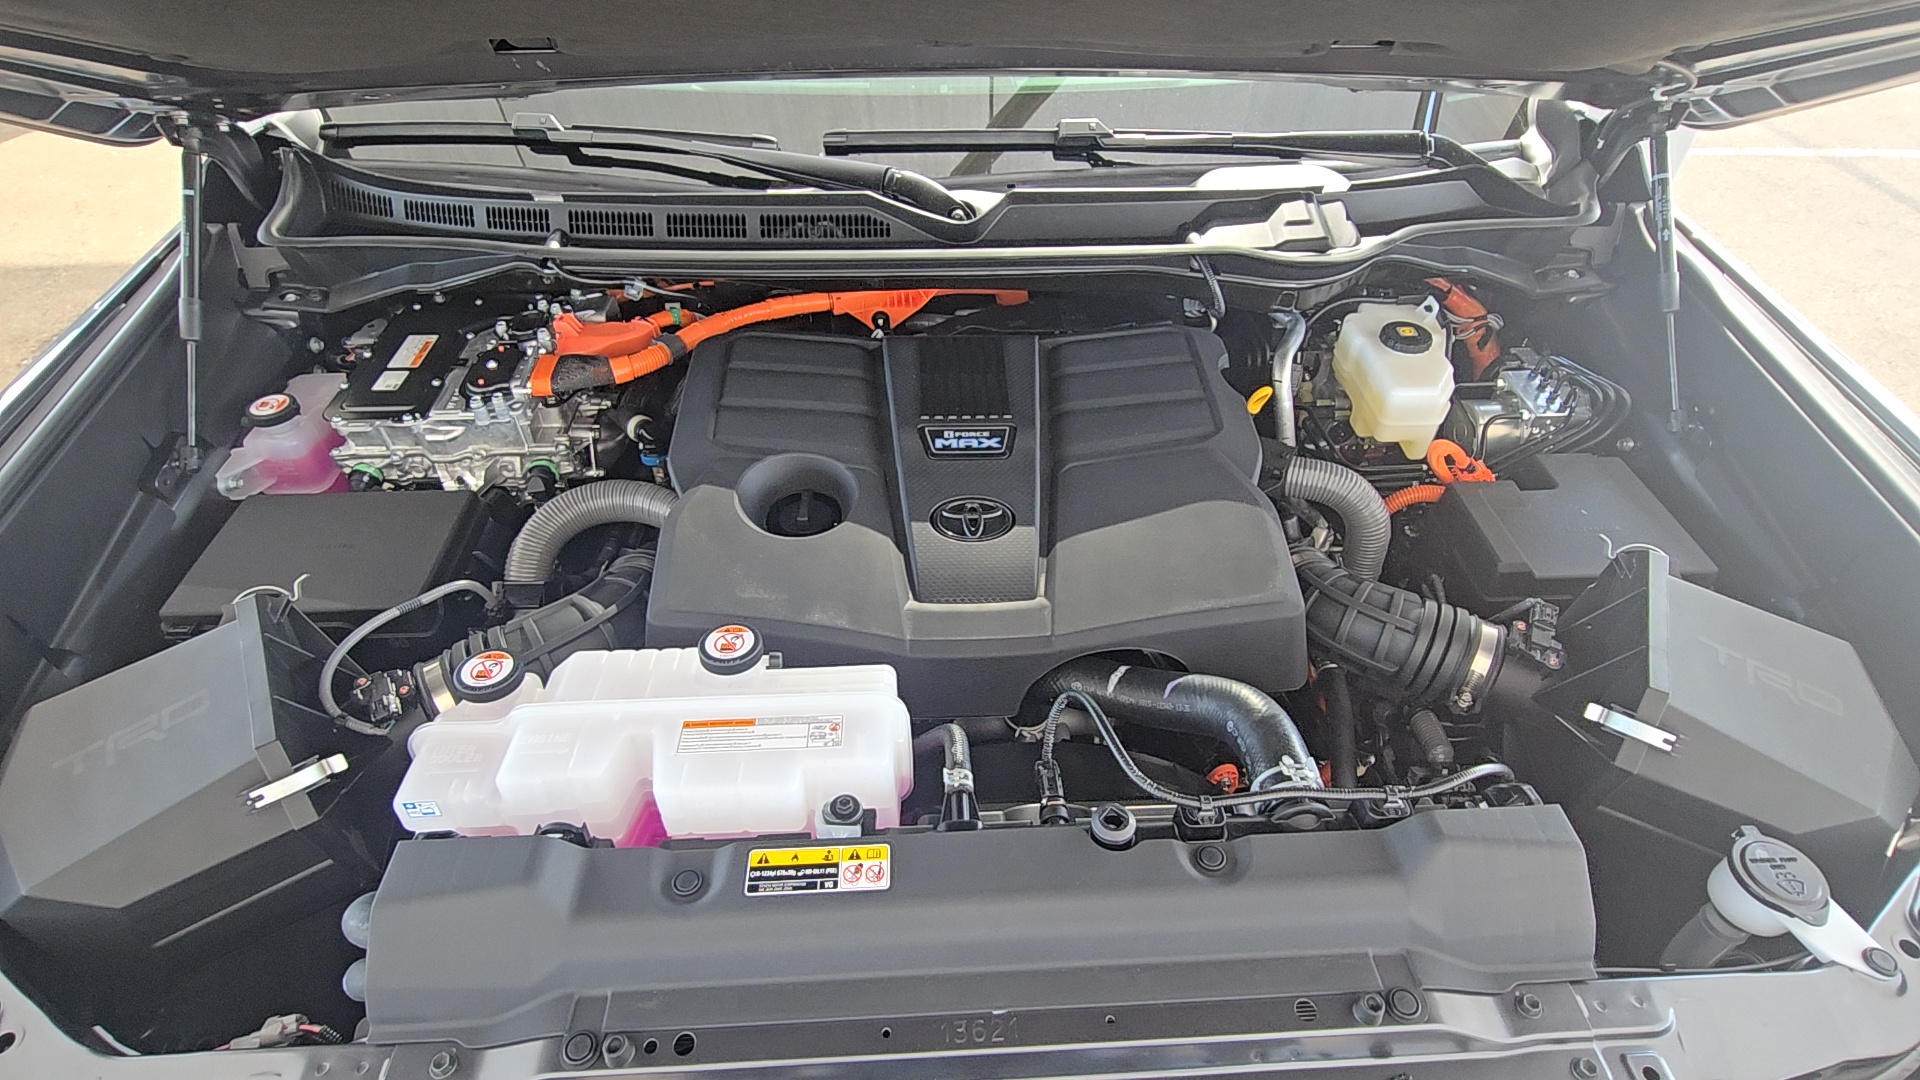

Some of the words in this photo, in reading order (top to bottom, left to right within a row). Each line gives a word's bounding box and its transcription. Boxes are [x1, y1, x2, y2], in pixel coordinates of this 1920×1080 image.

[935, 437, 1002, 448] MAX
[1700, 636, 1844, 717] TRD
[52, 688, 211, 776] TRD
[520, 733, 573, 745] ENGINE
[941, 1016, 1018, 1044] 13621
